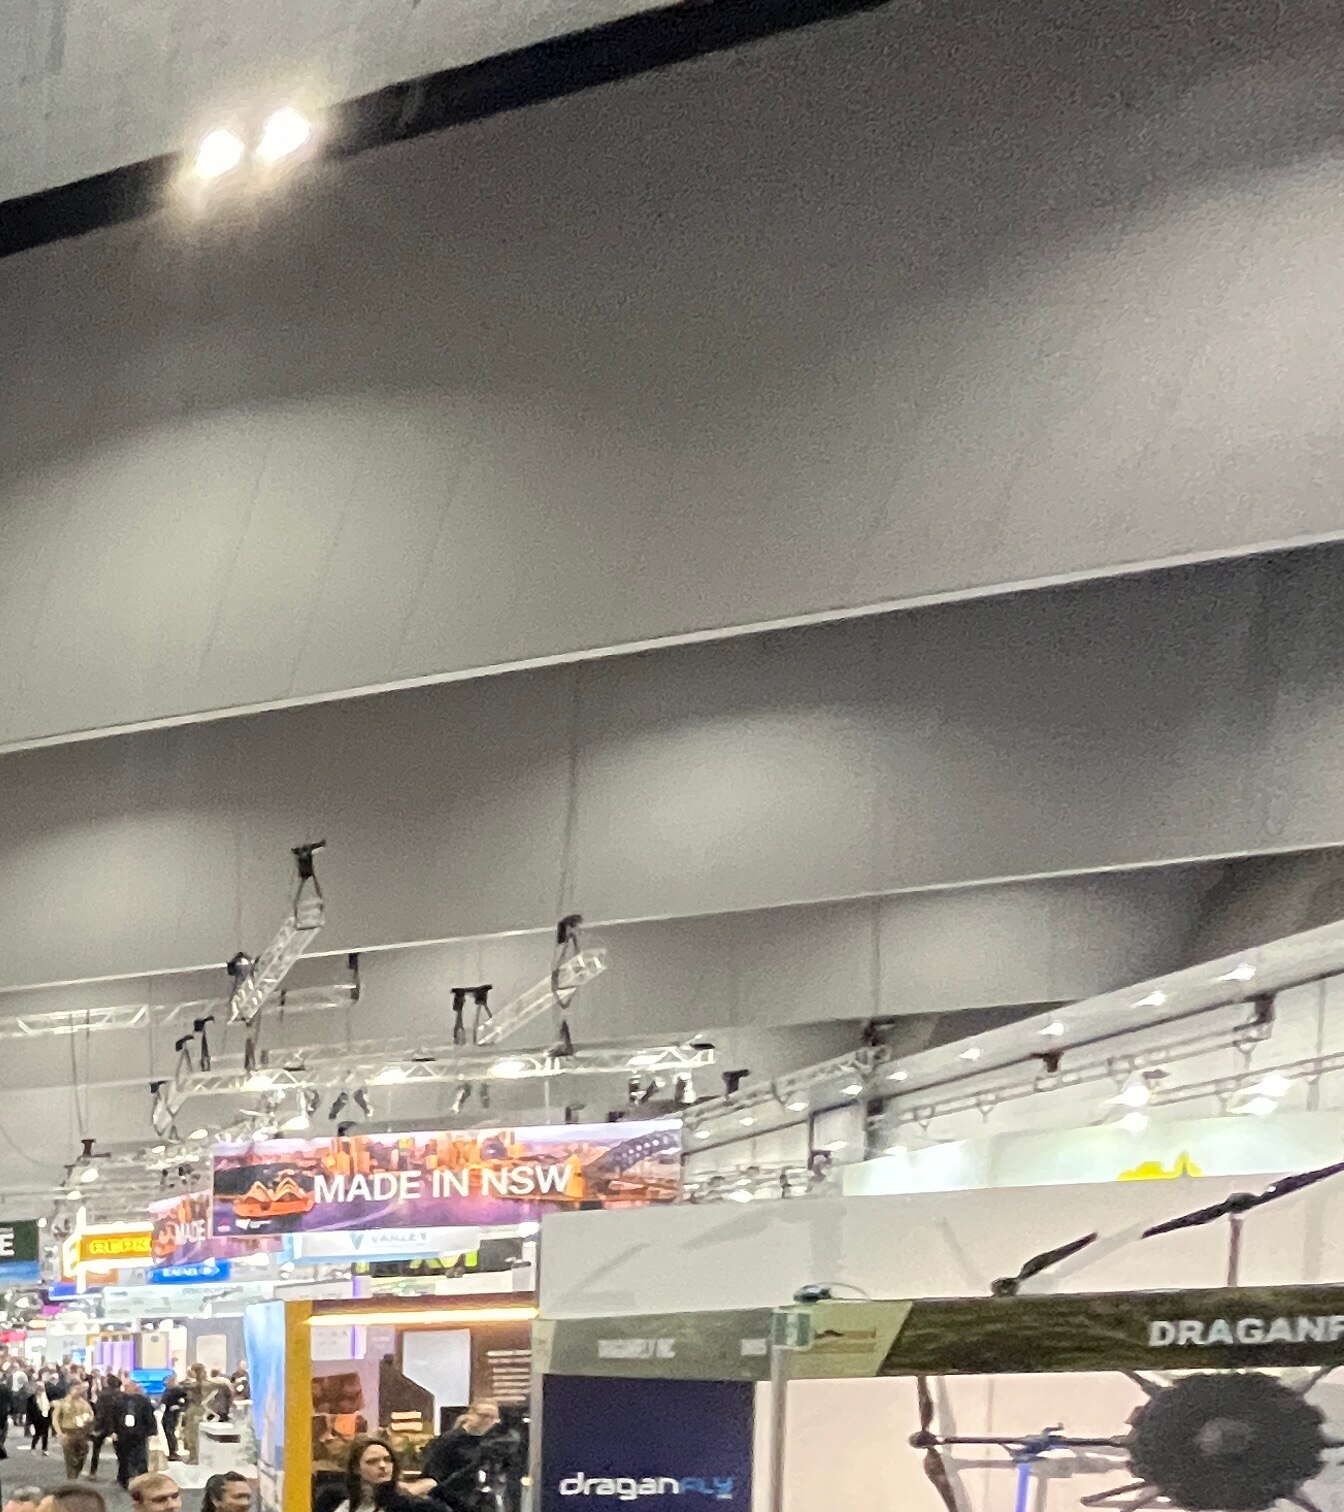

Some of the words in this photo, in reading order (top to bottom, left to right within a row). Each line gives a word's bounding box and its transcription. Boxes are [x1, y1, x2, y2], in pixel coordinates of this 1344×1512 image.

[314, 1169, 421, 1204] MADE
[432, 1168, 469, 1199] IN
[481, 1163, 574, 1197] NSW
